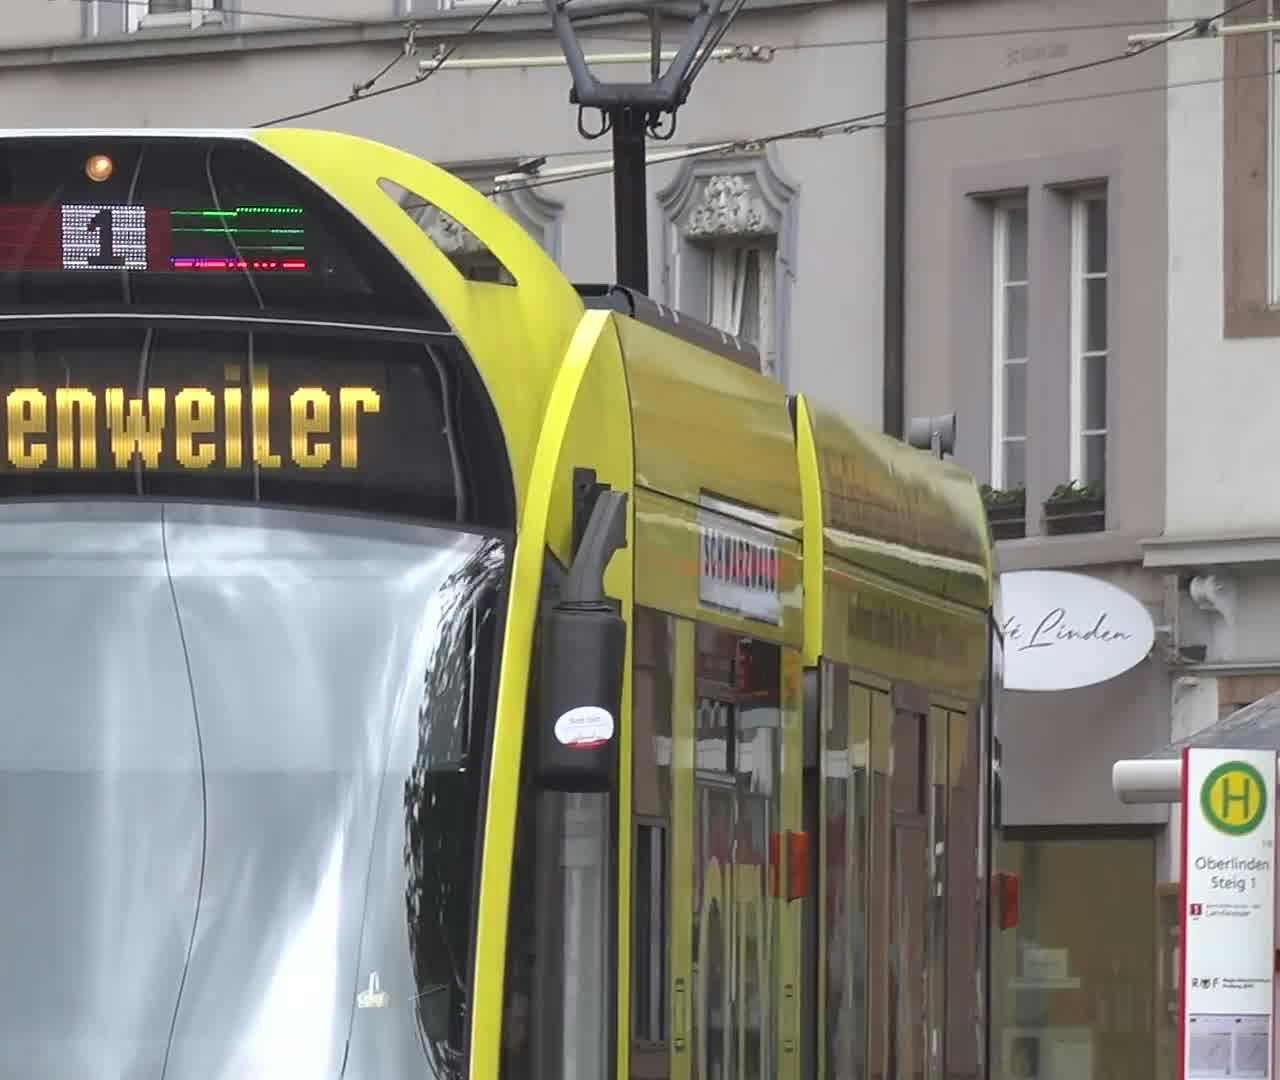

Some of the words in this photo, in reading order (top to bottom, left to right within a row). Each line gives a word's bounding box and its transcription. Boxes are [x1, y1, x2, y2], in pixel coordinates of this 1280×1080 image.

[86, 208, 126, 267] 1
[1017, 607, 1133, 652] Linden
[1194, 855, 1270, 872] Oberlinden
[1210, 875, 1247, 893] Steig
